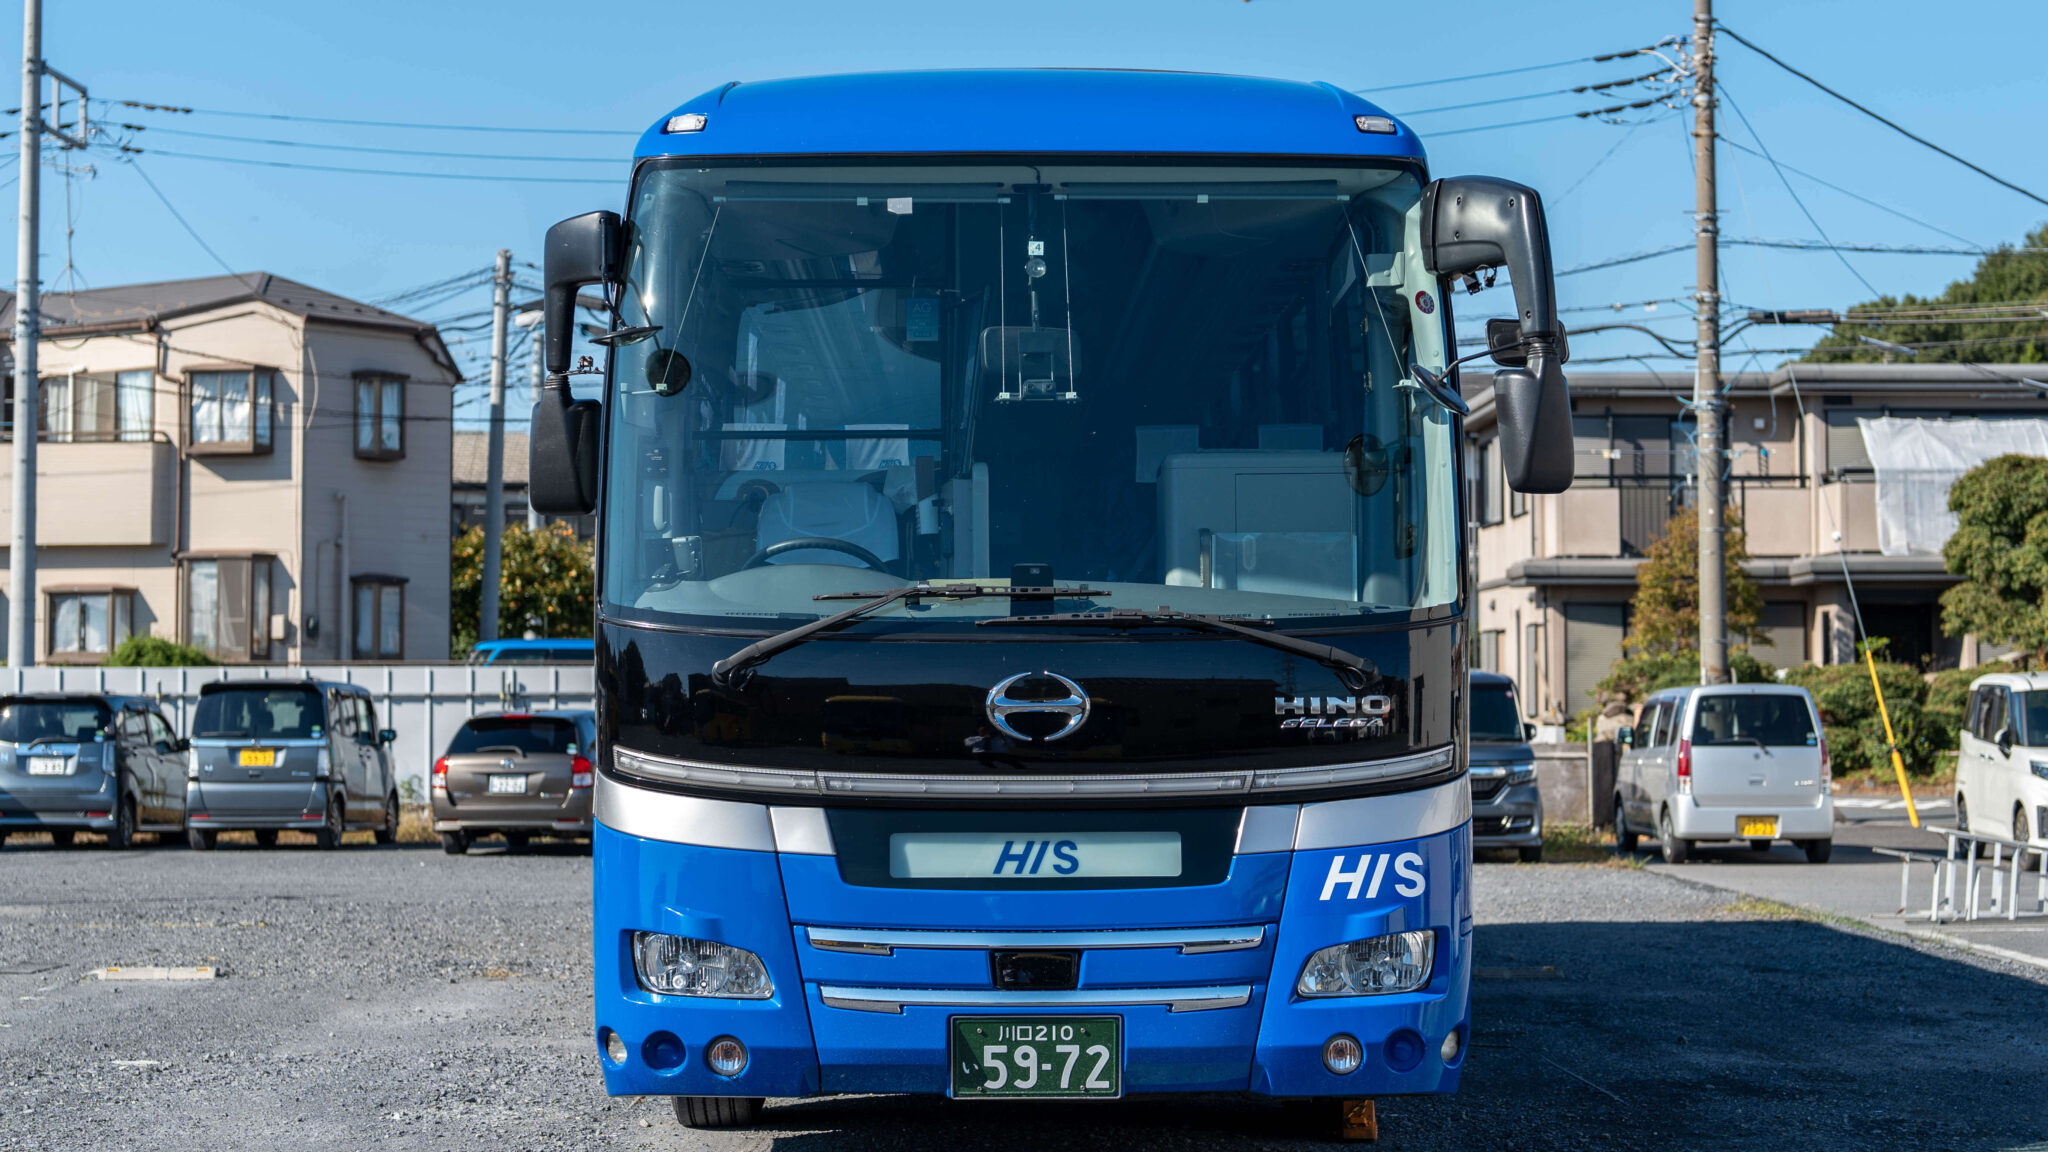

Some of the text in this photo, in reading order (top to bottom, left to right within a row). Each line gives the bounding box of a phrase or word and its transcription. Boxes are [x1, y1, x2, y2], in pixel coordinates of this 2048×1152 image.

[1274, 695, 1391, 715] HINO
[992, 840, 1079, 875] HIS
[1319, 852, 1426, 900] HIS
[983, 1044, 1110, 1090] 59-72
